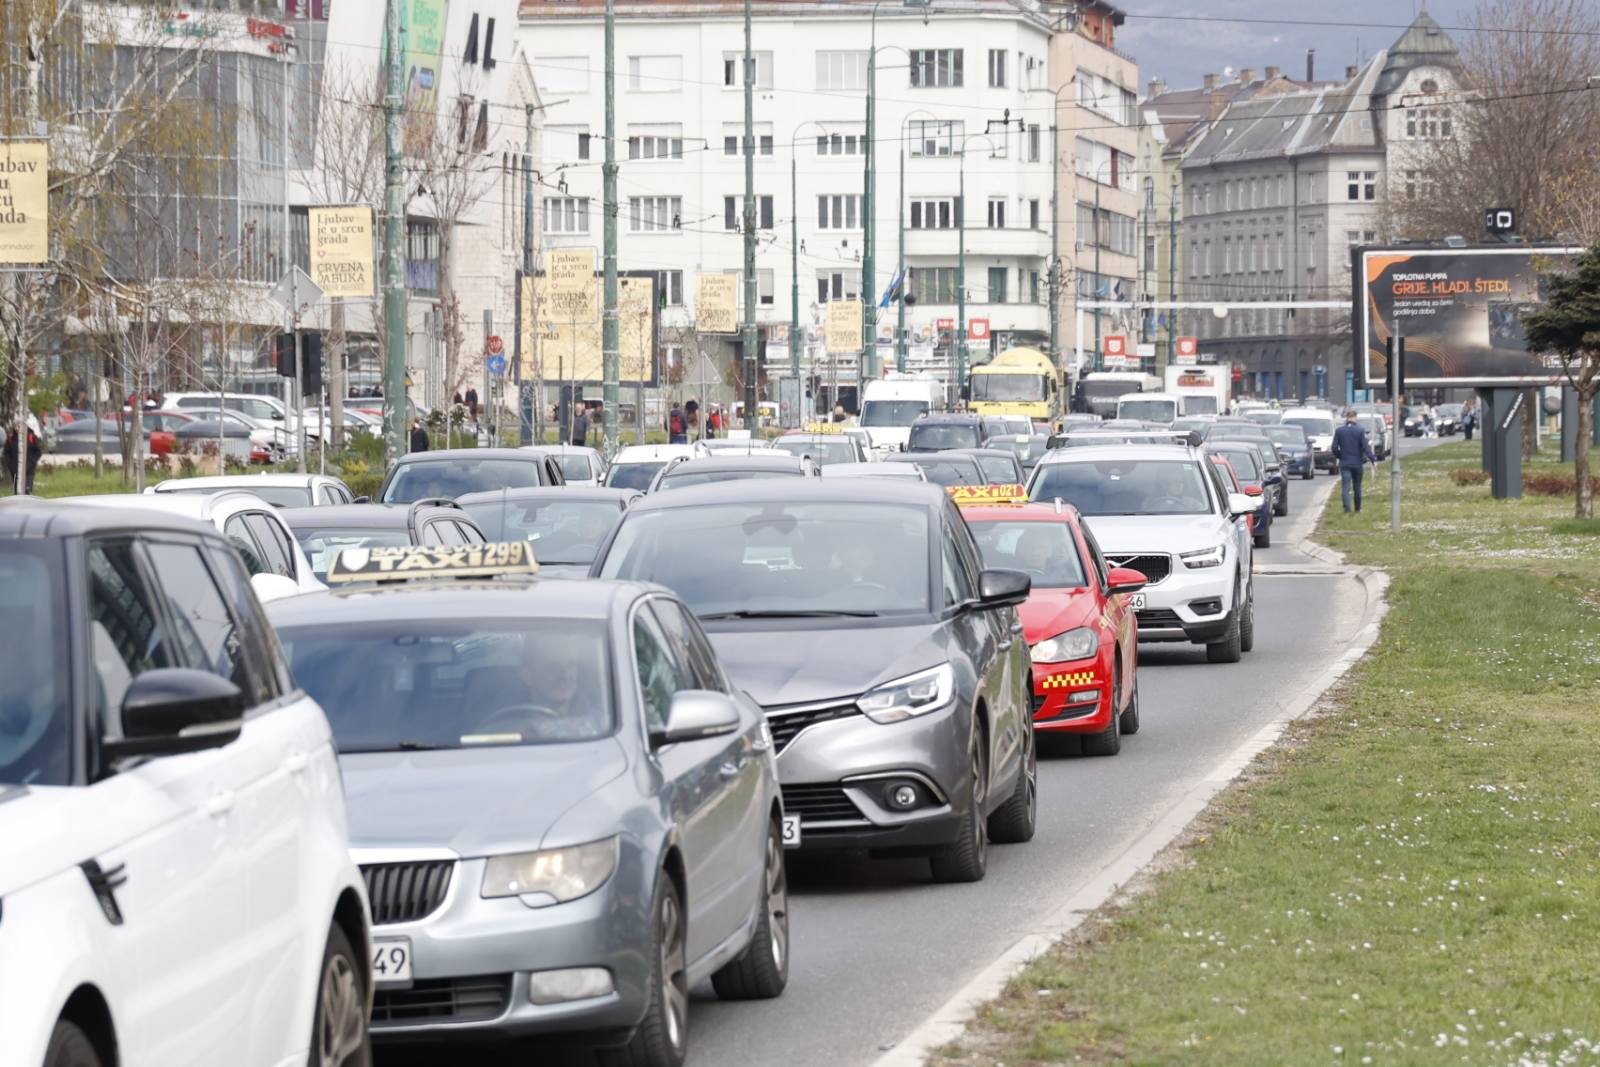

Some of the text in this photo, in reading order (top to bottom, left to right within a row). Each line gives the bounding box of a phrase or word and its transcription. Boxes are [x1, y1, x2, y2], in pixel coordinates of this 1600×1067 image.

[317, 214, 354, 225] Ljubav
[317, 226, 326, 236] je
[317, 234, 348, 246] grada
[316, 262, 364, 274] CRVENA
[317, 272, 365, 284] JABUKA
[1392, 272, 1448, 281] TOPLOTNA PUMPA
[1392, 278, 1512, 294] GRIJE. HLADI. ŠTEDI.
[1000, 484, 1017, 497] 021
[371, 542, 524, 570] TAXI 299
[783, 820, 794, 840] 3
[374, 946, 406, 974] 49
